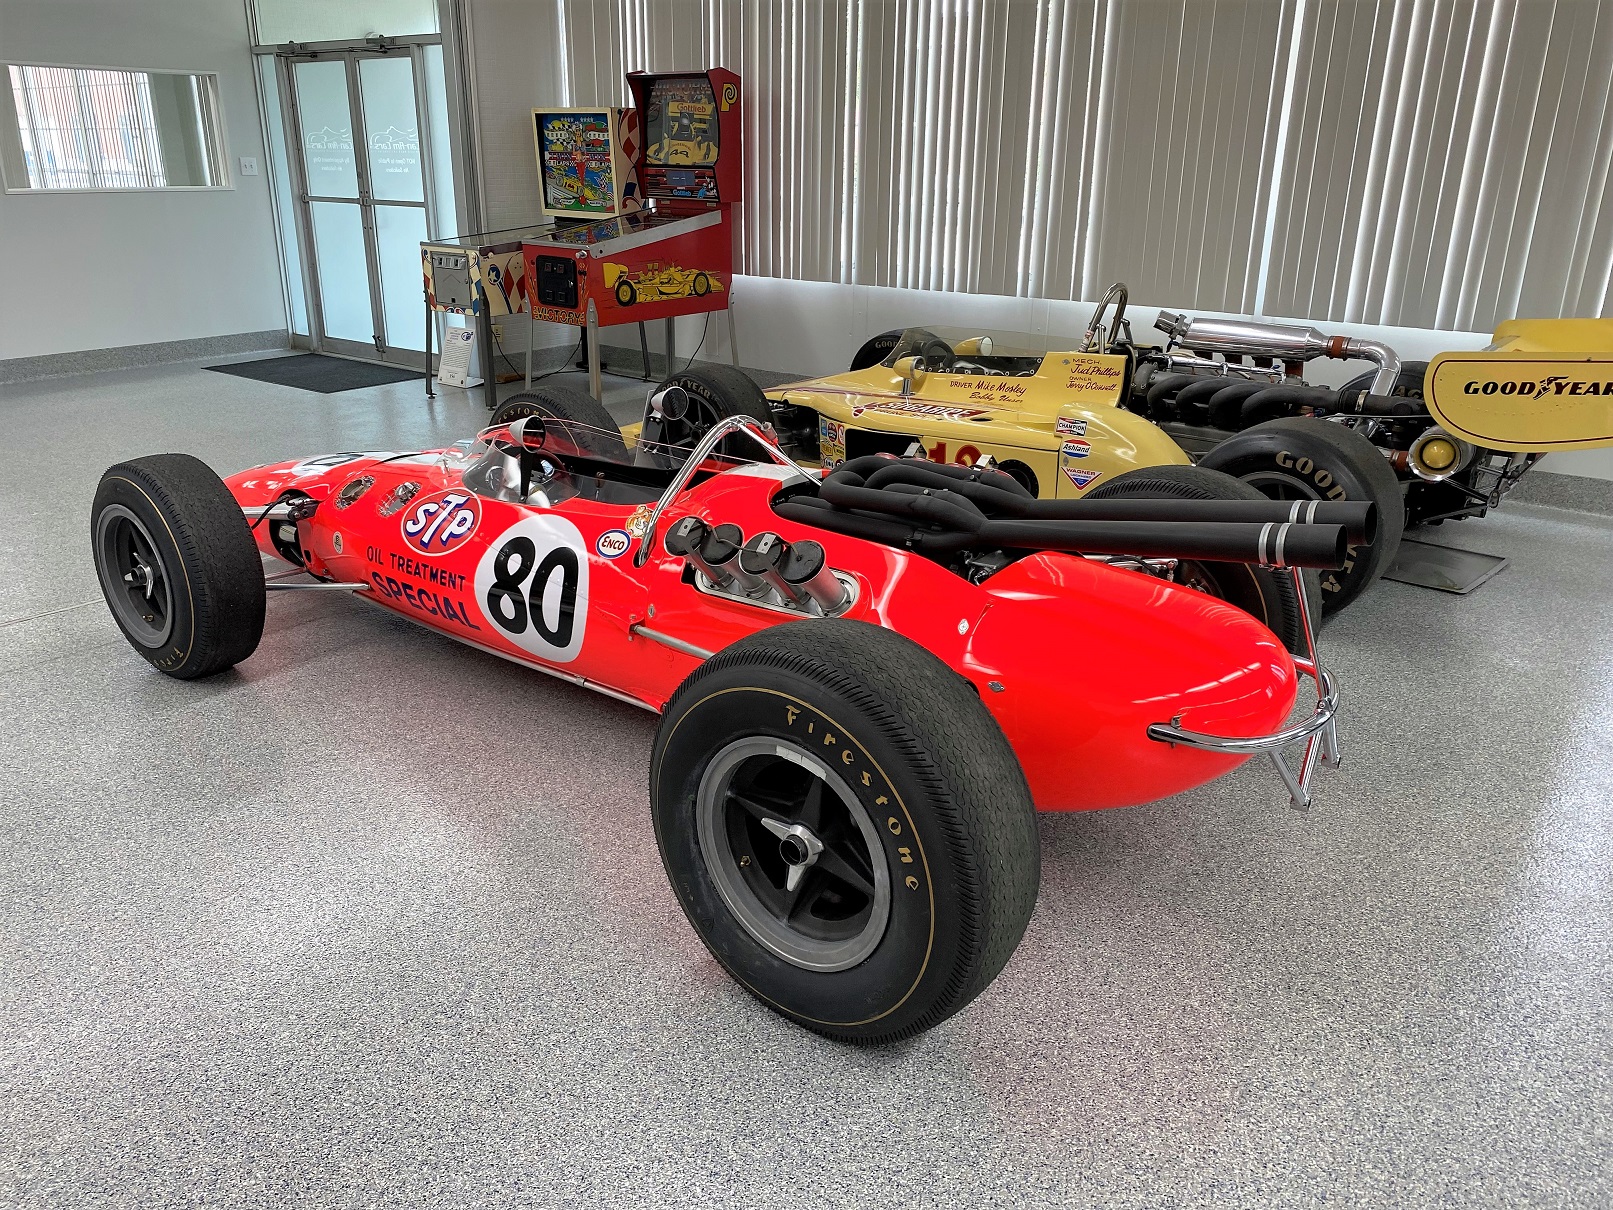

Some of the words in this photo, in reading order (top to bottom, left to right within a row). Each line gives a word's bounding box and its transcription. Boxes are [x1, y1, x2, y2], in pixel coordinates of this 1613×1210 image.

[677, 102, 707, 113] Gottlieb
[537, 306, 580, 325] VICTORY
[950, 380, 973, 389] DRIVER
[975, 380, 996, 391] Mike
[996, 382, 1027, 398] Mosley
[969, 391, 995, 402] Bobby
[1059, 422, 1085, 431] CHAMPION
[1063, 444, 1090, 453] Ashland
[1066, 468, 1095, 476] WAGNER
[405, 493, 475, 549] STP
[602, 536, 625, 551] ENCO
[366, 545, 384, 565] OIL
[390, 552, 467, 592] TREATMENT
[371, 571, 482, 631] SPECIAL
[486, 536, 579, 648] 80
[785, 705, 921, 892] Firestone
